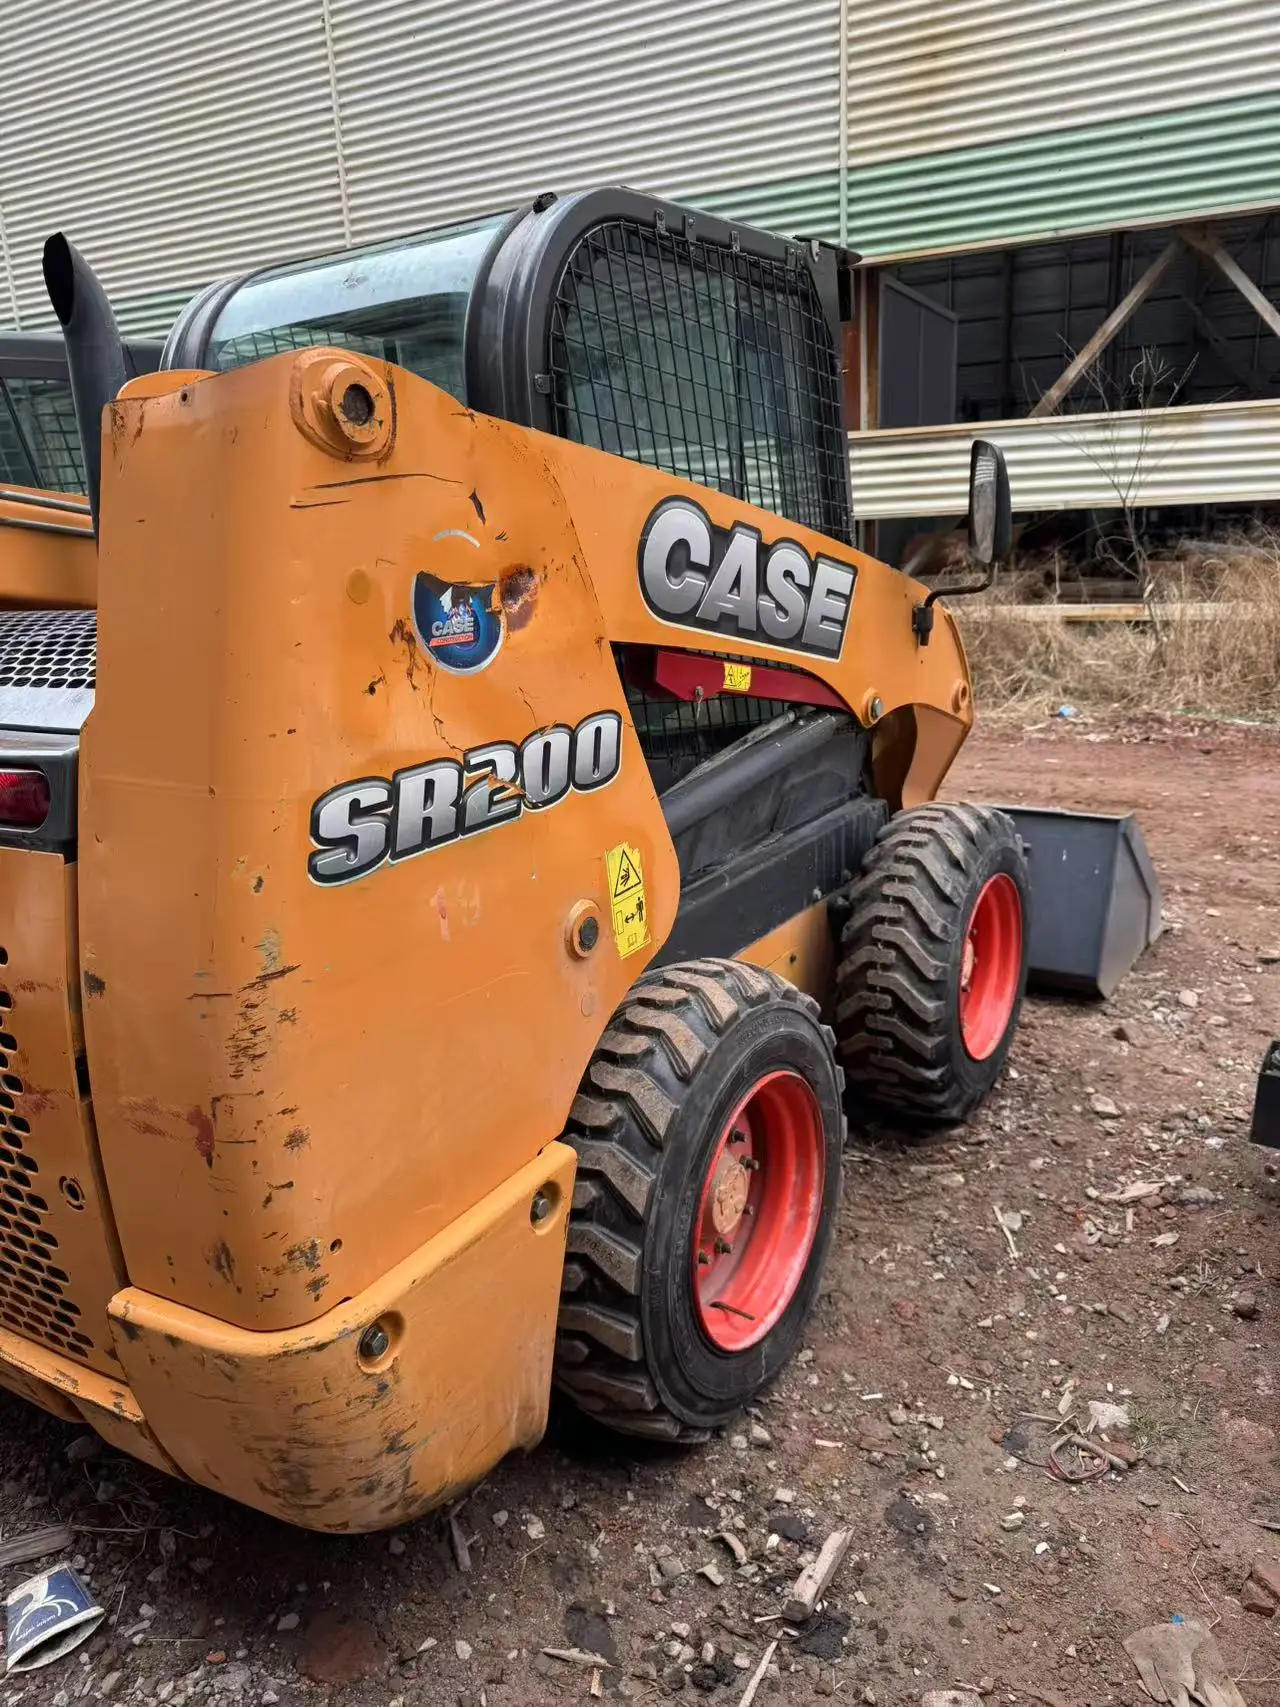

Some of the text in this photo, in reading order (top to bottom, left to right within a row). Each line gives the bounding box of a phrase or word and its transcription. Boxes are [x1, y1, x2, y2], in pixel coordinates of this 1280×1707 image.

[431, 617, 474, 636] CASE
[641, 502, 856, 653] CASE
[311, 712, 622, 880] SR200
